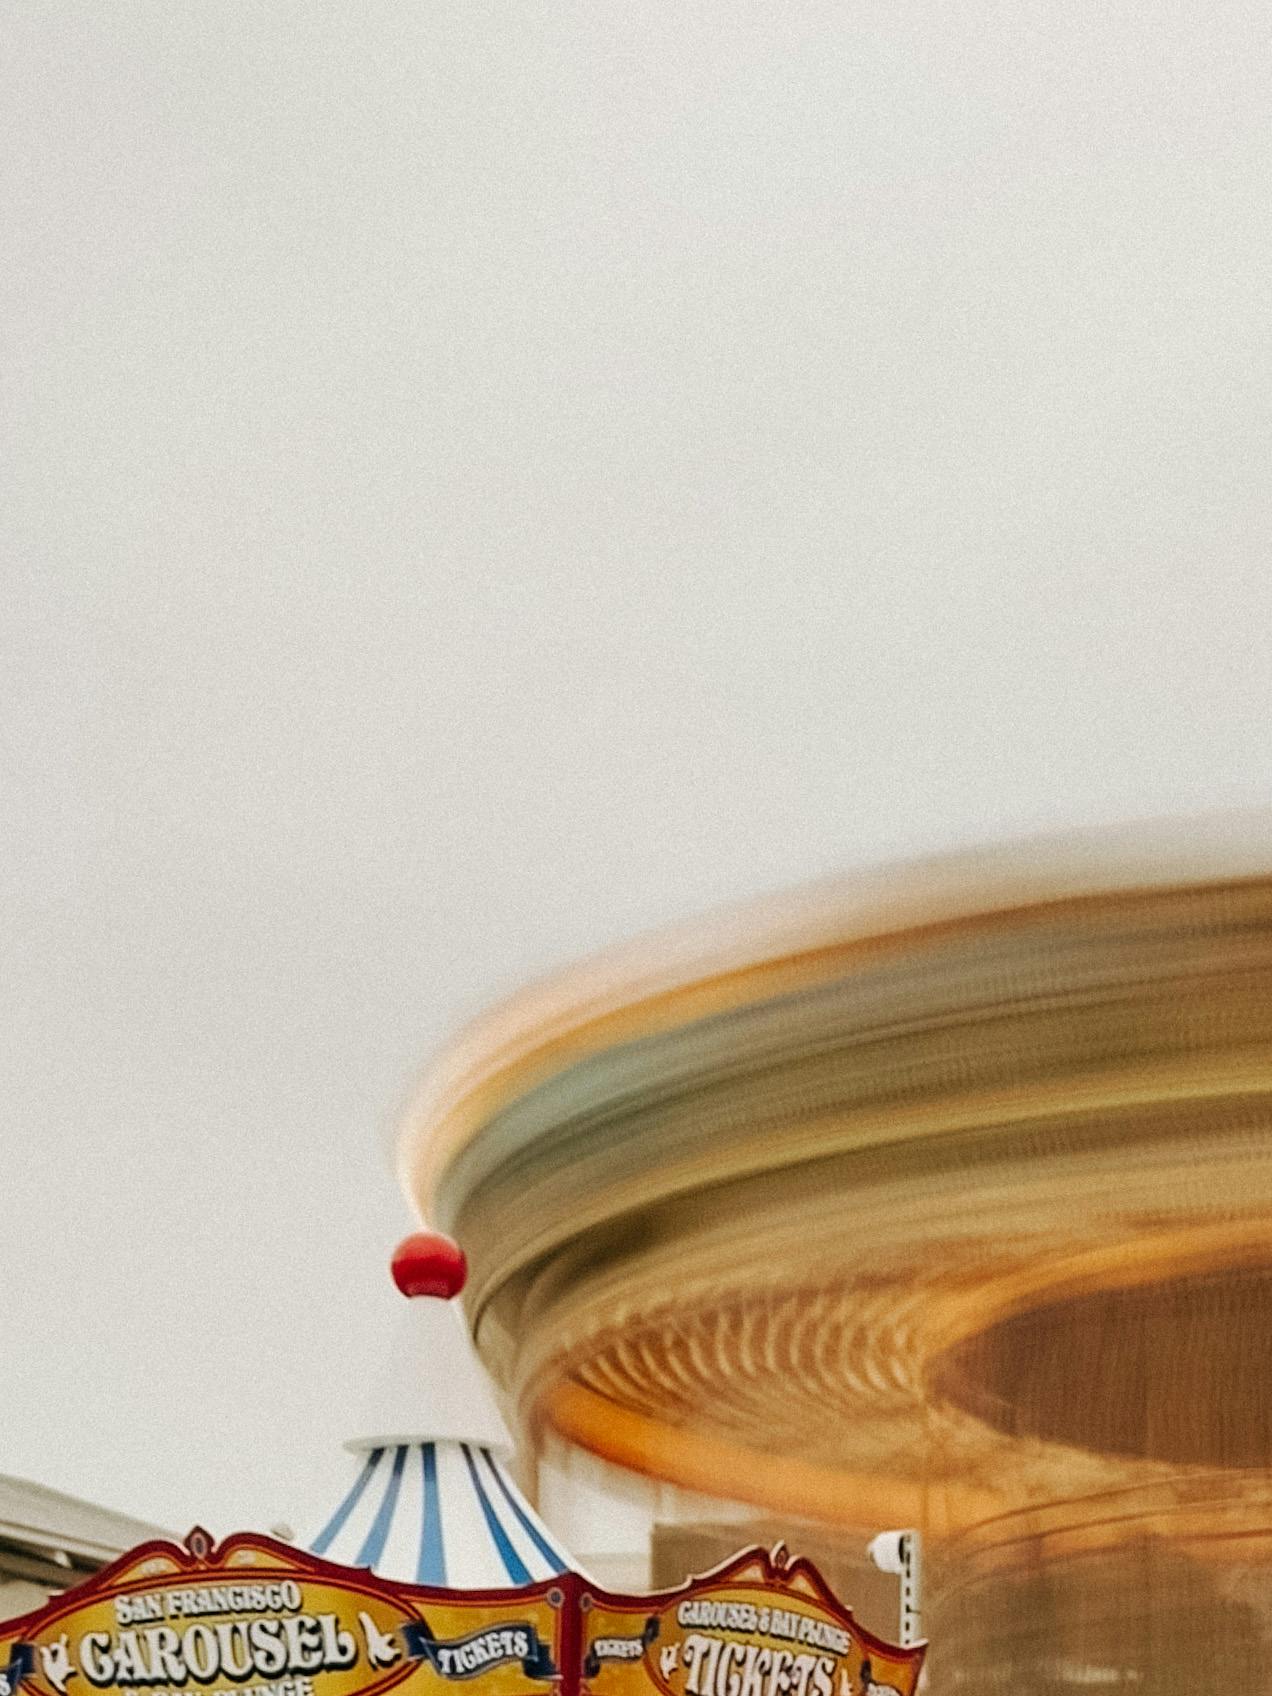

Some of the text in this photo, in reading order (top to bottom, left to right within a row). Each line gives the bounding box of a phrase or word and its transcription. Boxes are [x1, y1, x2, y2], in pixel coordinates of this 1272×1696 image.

[114, 1580, 302, 1625] SAN FRANCISCO
[678, 1599, 758, 1632] CAROUSEL
[80, 1612, 357, 1685] CAROUSEL
[437, 1630, 530, 1675] TICKETS
